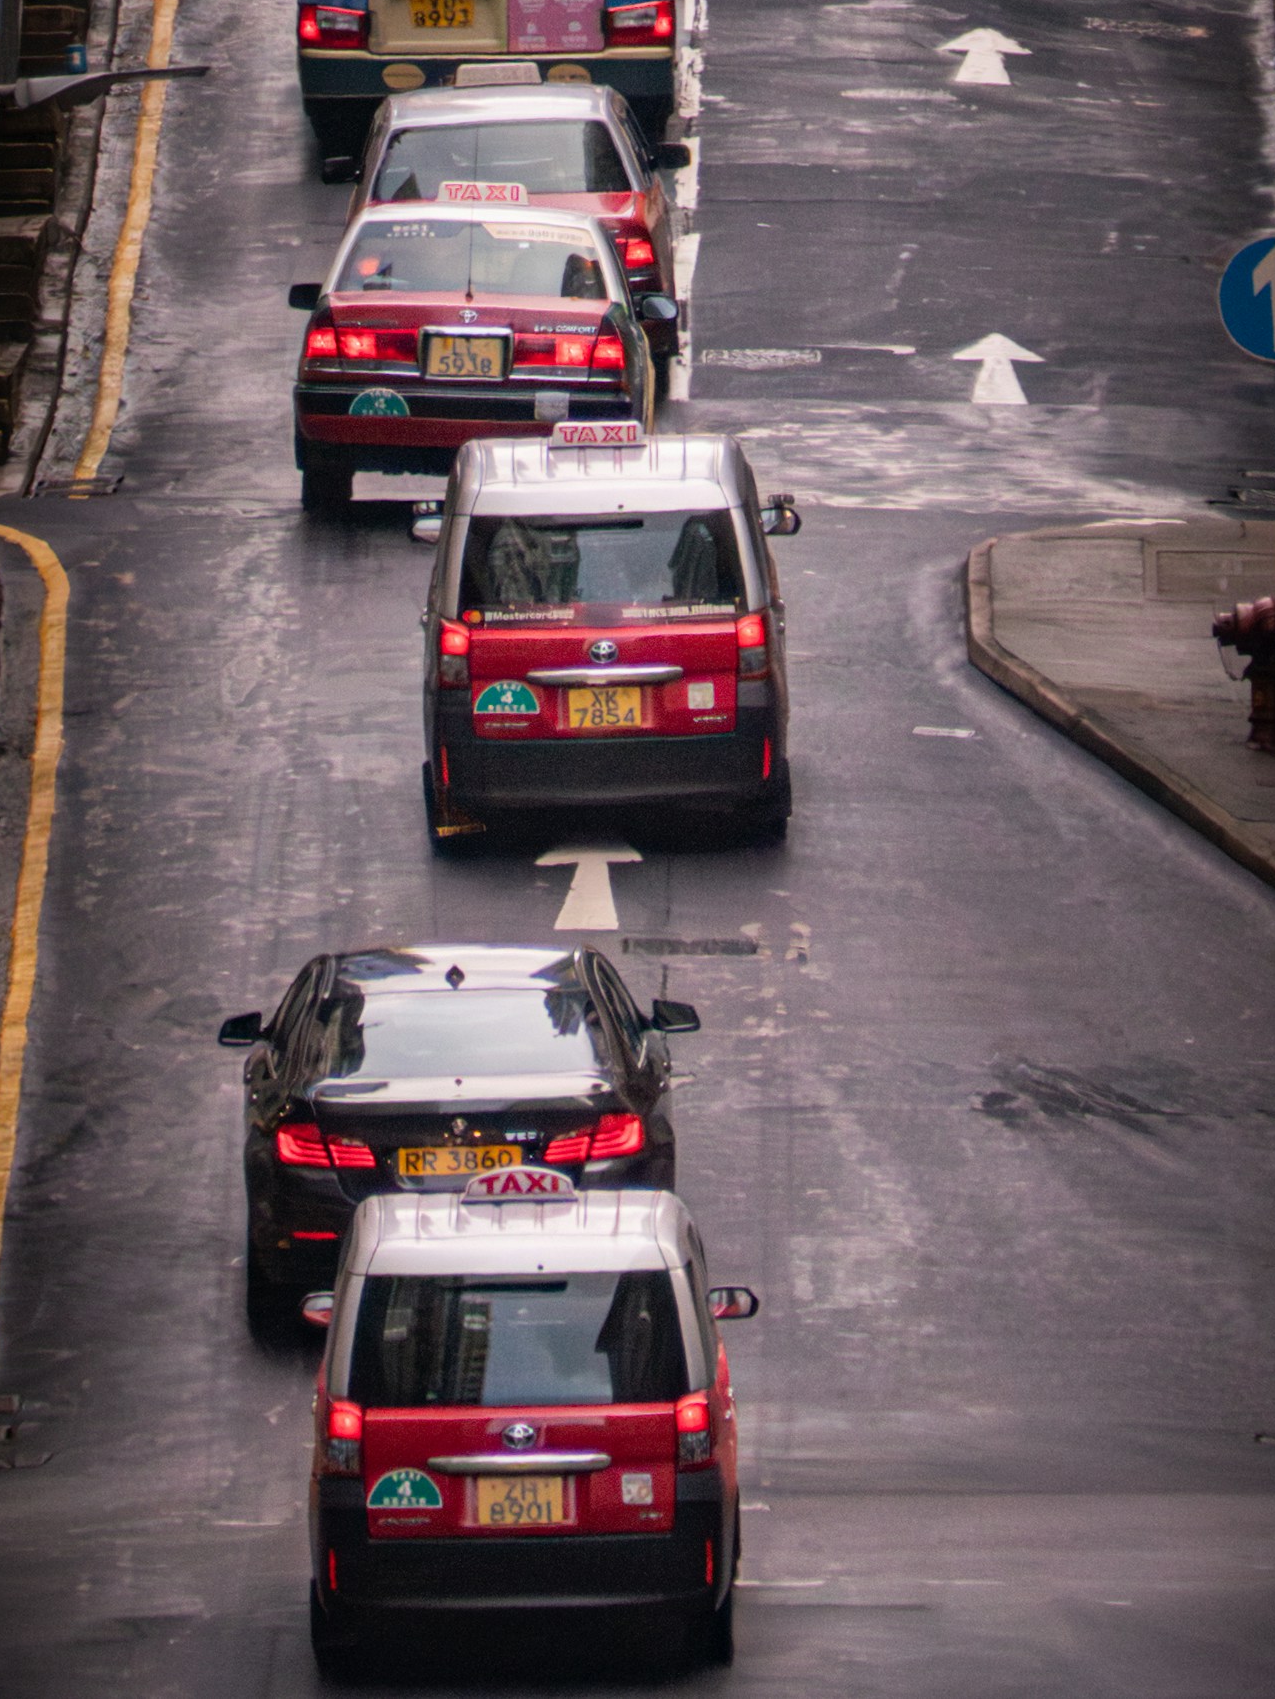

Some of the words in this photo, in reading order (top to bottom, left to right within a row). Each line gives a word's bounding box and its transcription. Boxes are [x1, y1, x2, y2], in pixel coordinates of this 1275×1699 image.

[445, 183, 520, 202] TAXI
[559, 425, 637, 443] TAXI
[573, 707, 636, 728] 7854
[405, 1153, 438, 1173] RR
[447, 1149, 514, 1171] 3860
[479, 1173, 561, 1195] TAXI
[396, 1480, 413, 1497] 4
[490, 1501, 553, 1523] 8901
